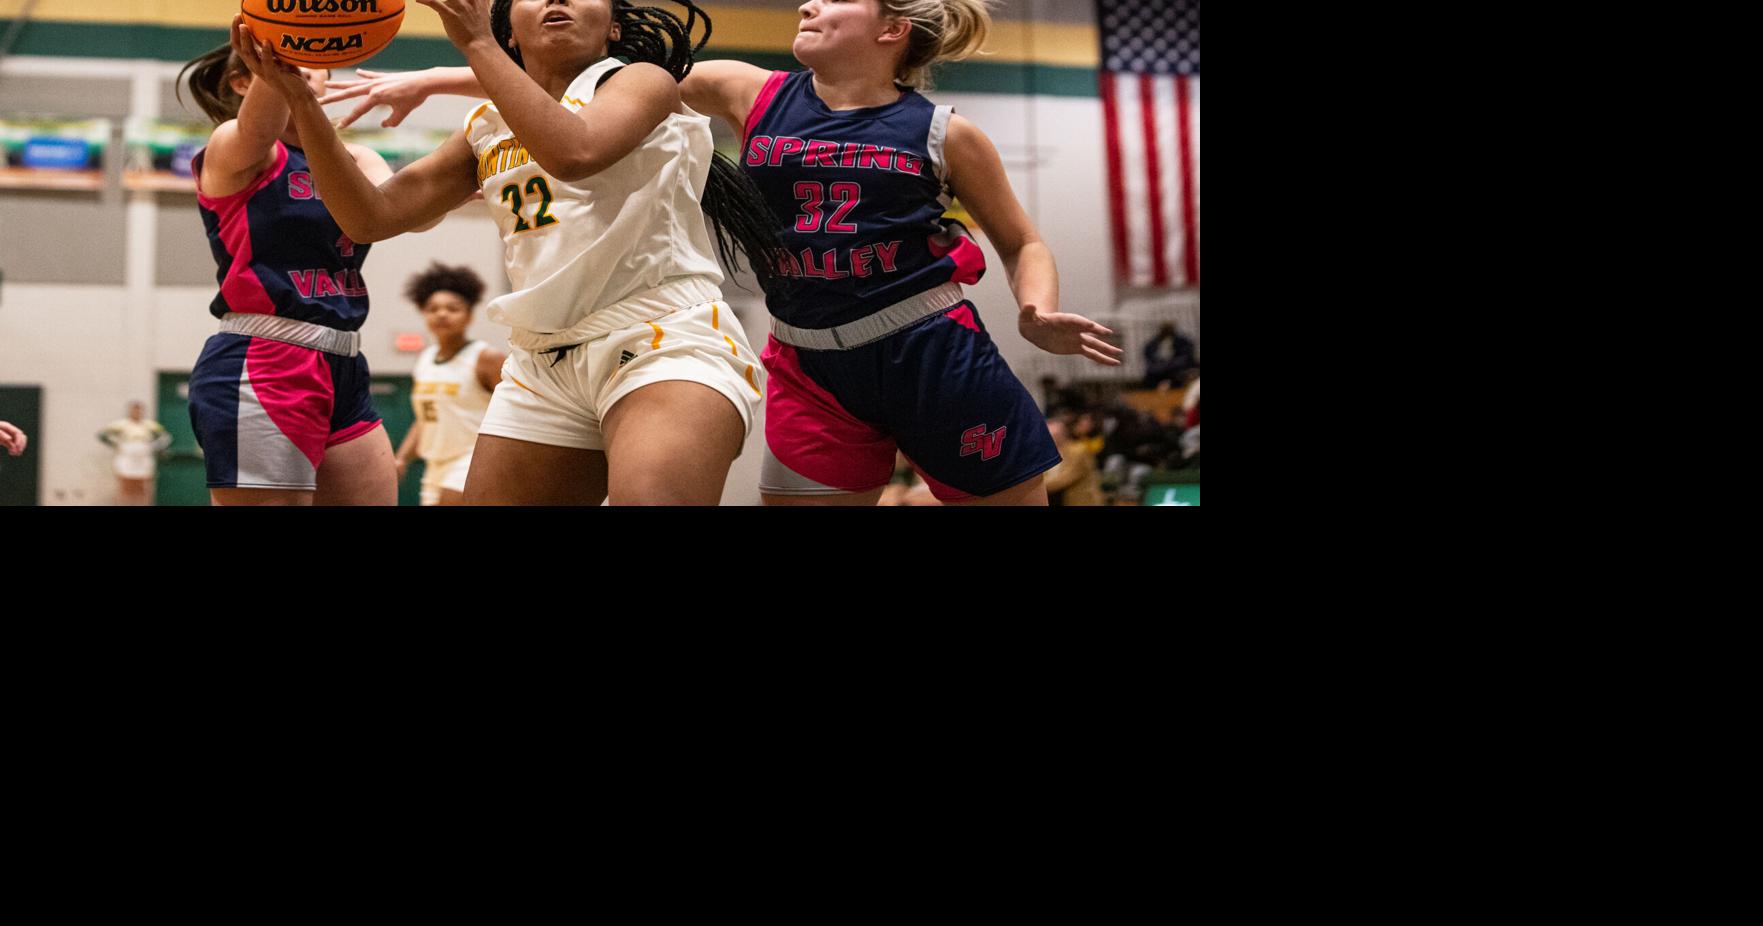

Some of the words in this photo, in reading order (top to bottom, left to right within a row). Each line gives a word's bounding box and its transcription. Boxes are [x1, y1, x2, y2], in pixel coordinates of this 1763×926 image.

[279, 32, 364, 52] NCAA
[746, 135, 924, 176] SPRING
[501, 175, 560, 234] 22
[793, 181, 861, 233] 32
[769, 240, 903, 280] ALLEY
[960, 423, 1007, 461] SV
